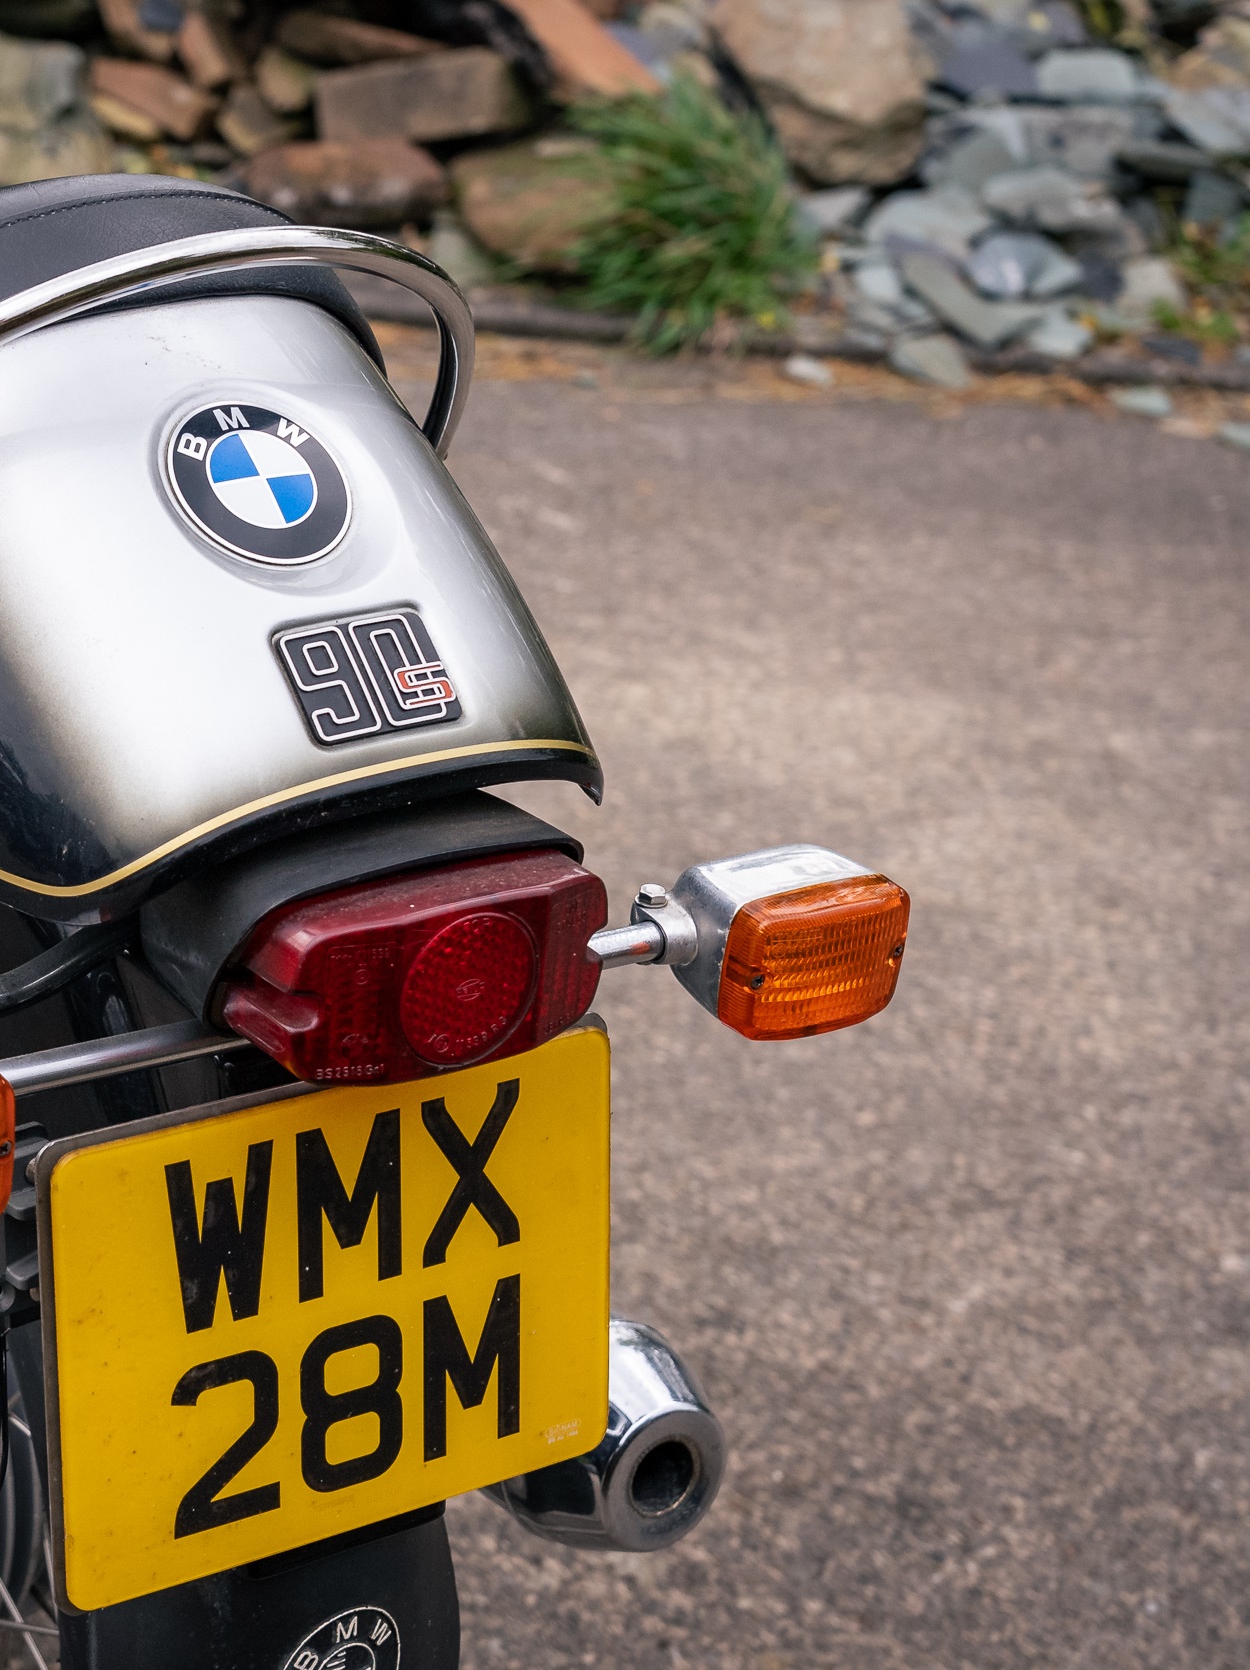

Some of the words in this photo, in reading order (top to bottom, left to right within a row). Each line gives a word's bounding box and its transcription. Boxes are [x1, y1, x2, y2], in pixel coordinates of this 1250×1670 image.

[177, 406, 310, 461] BMW
[164, 1077, 521, 1334] WMX
[170, 1273, 521, 1540] 28M
[293, 1615, 392, 1670] BMW
